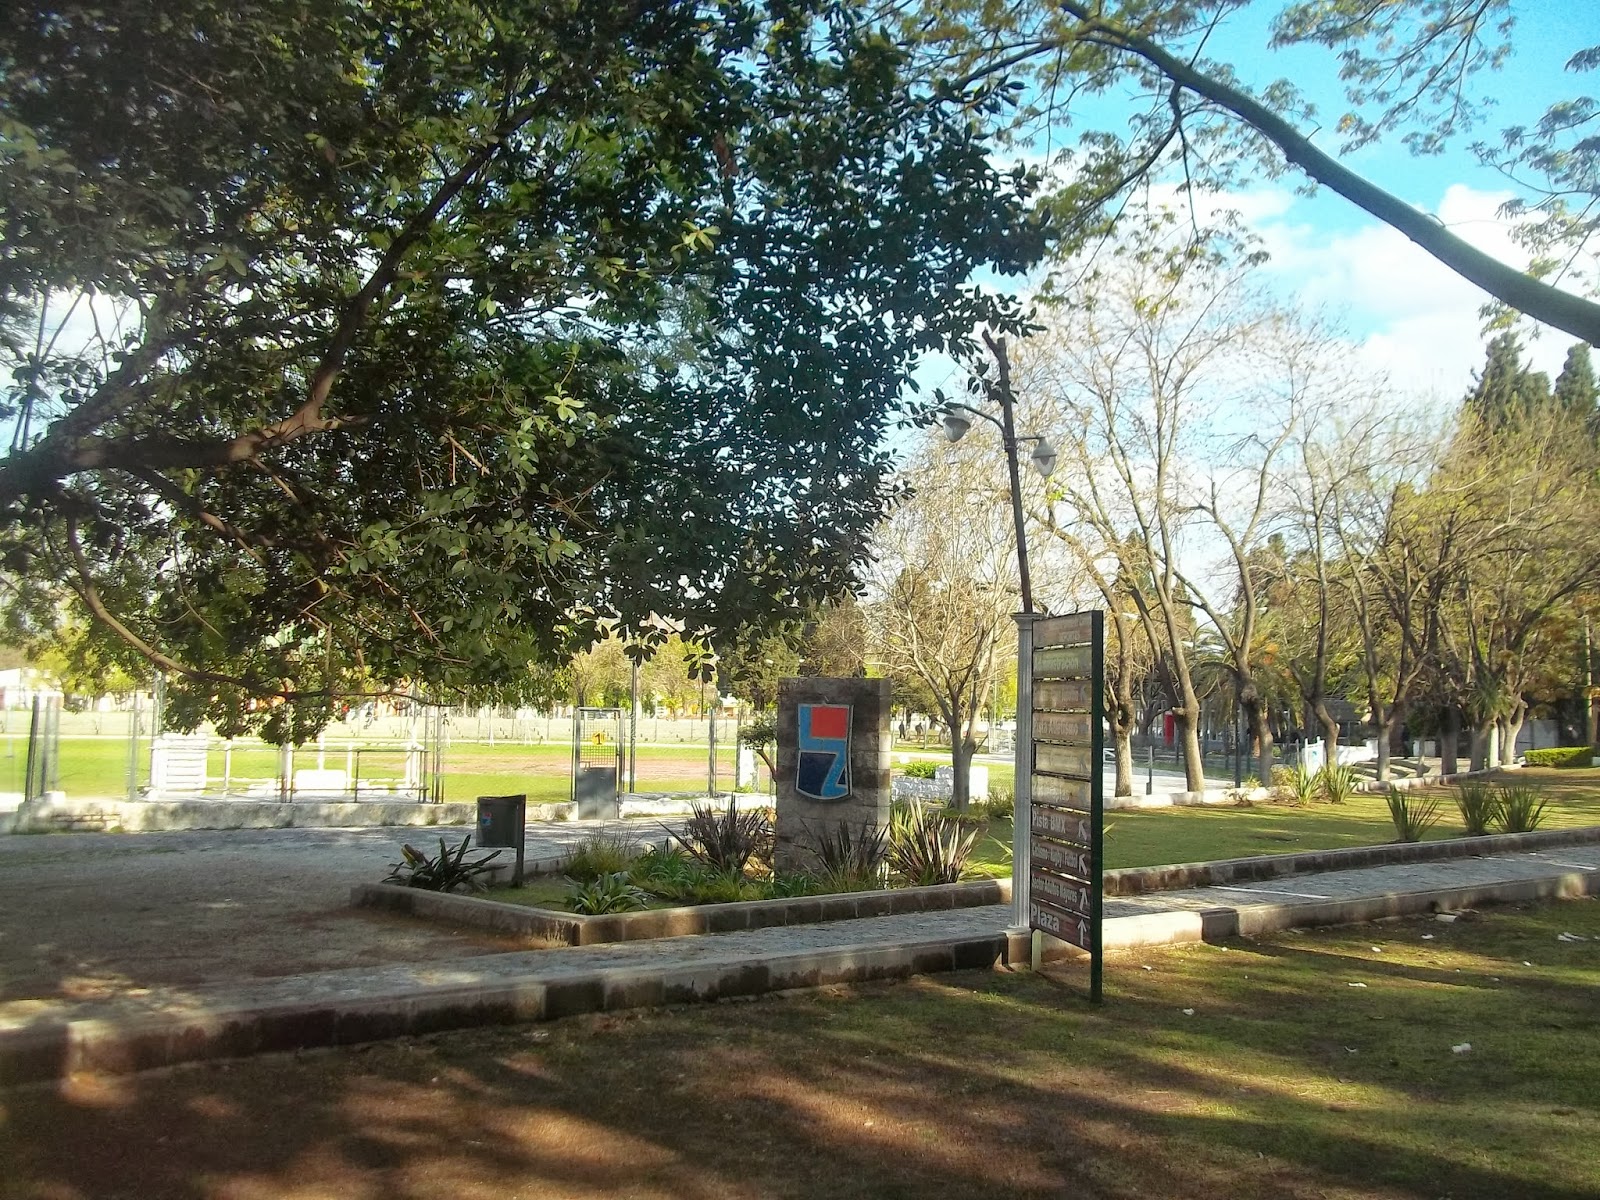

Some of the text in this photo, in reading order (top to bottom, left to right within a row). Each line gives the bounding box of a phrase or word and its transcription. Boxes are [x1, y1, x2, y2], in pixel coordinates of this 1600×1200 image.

[1031, 806, 1066, 834] Pista BMX
[1030, 903, 1060, 933] Plaza
